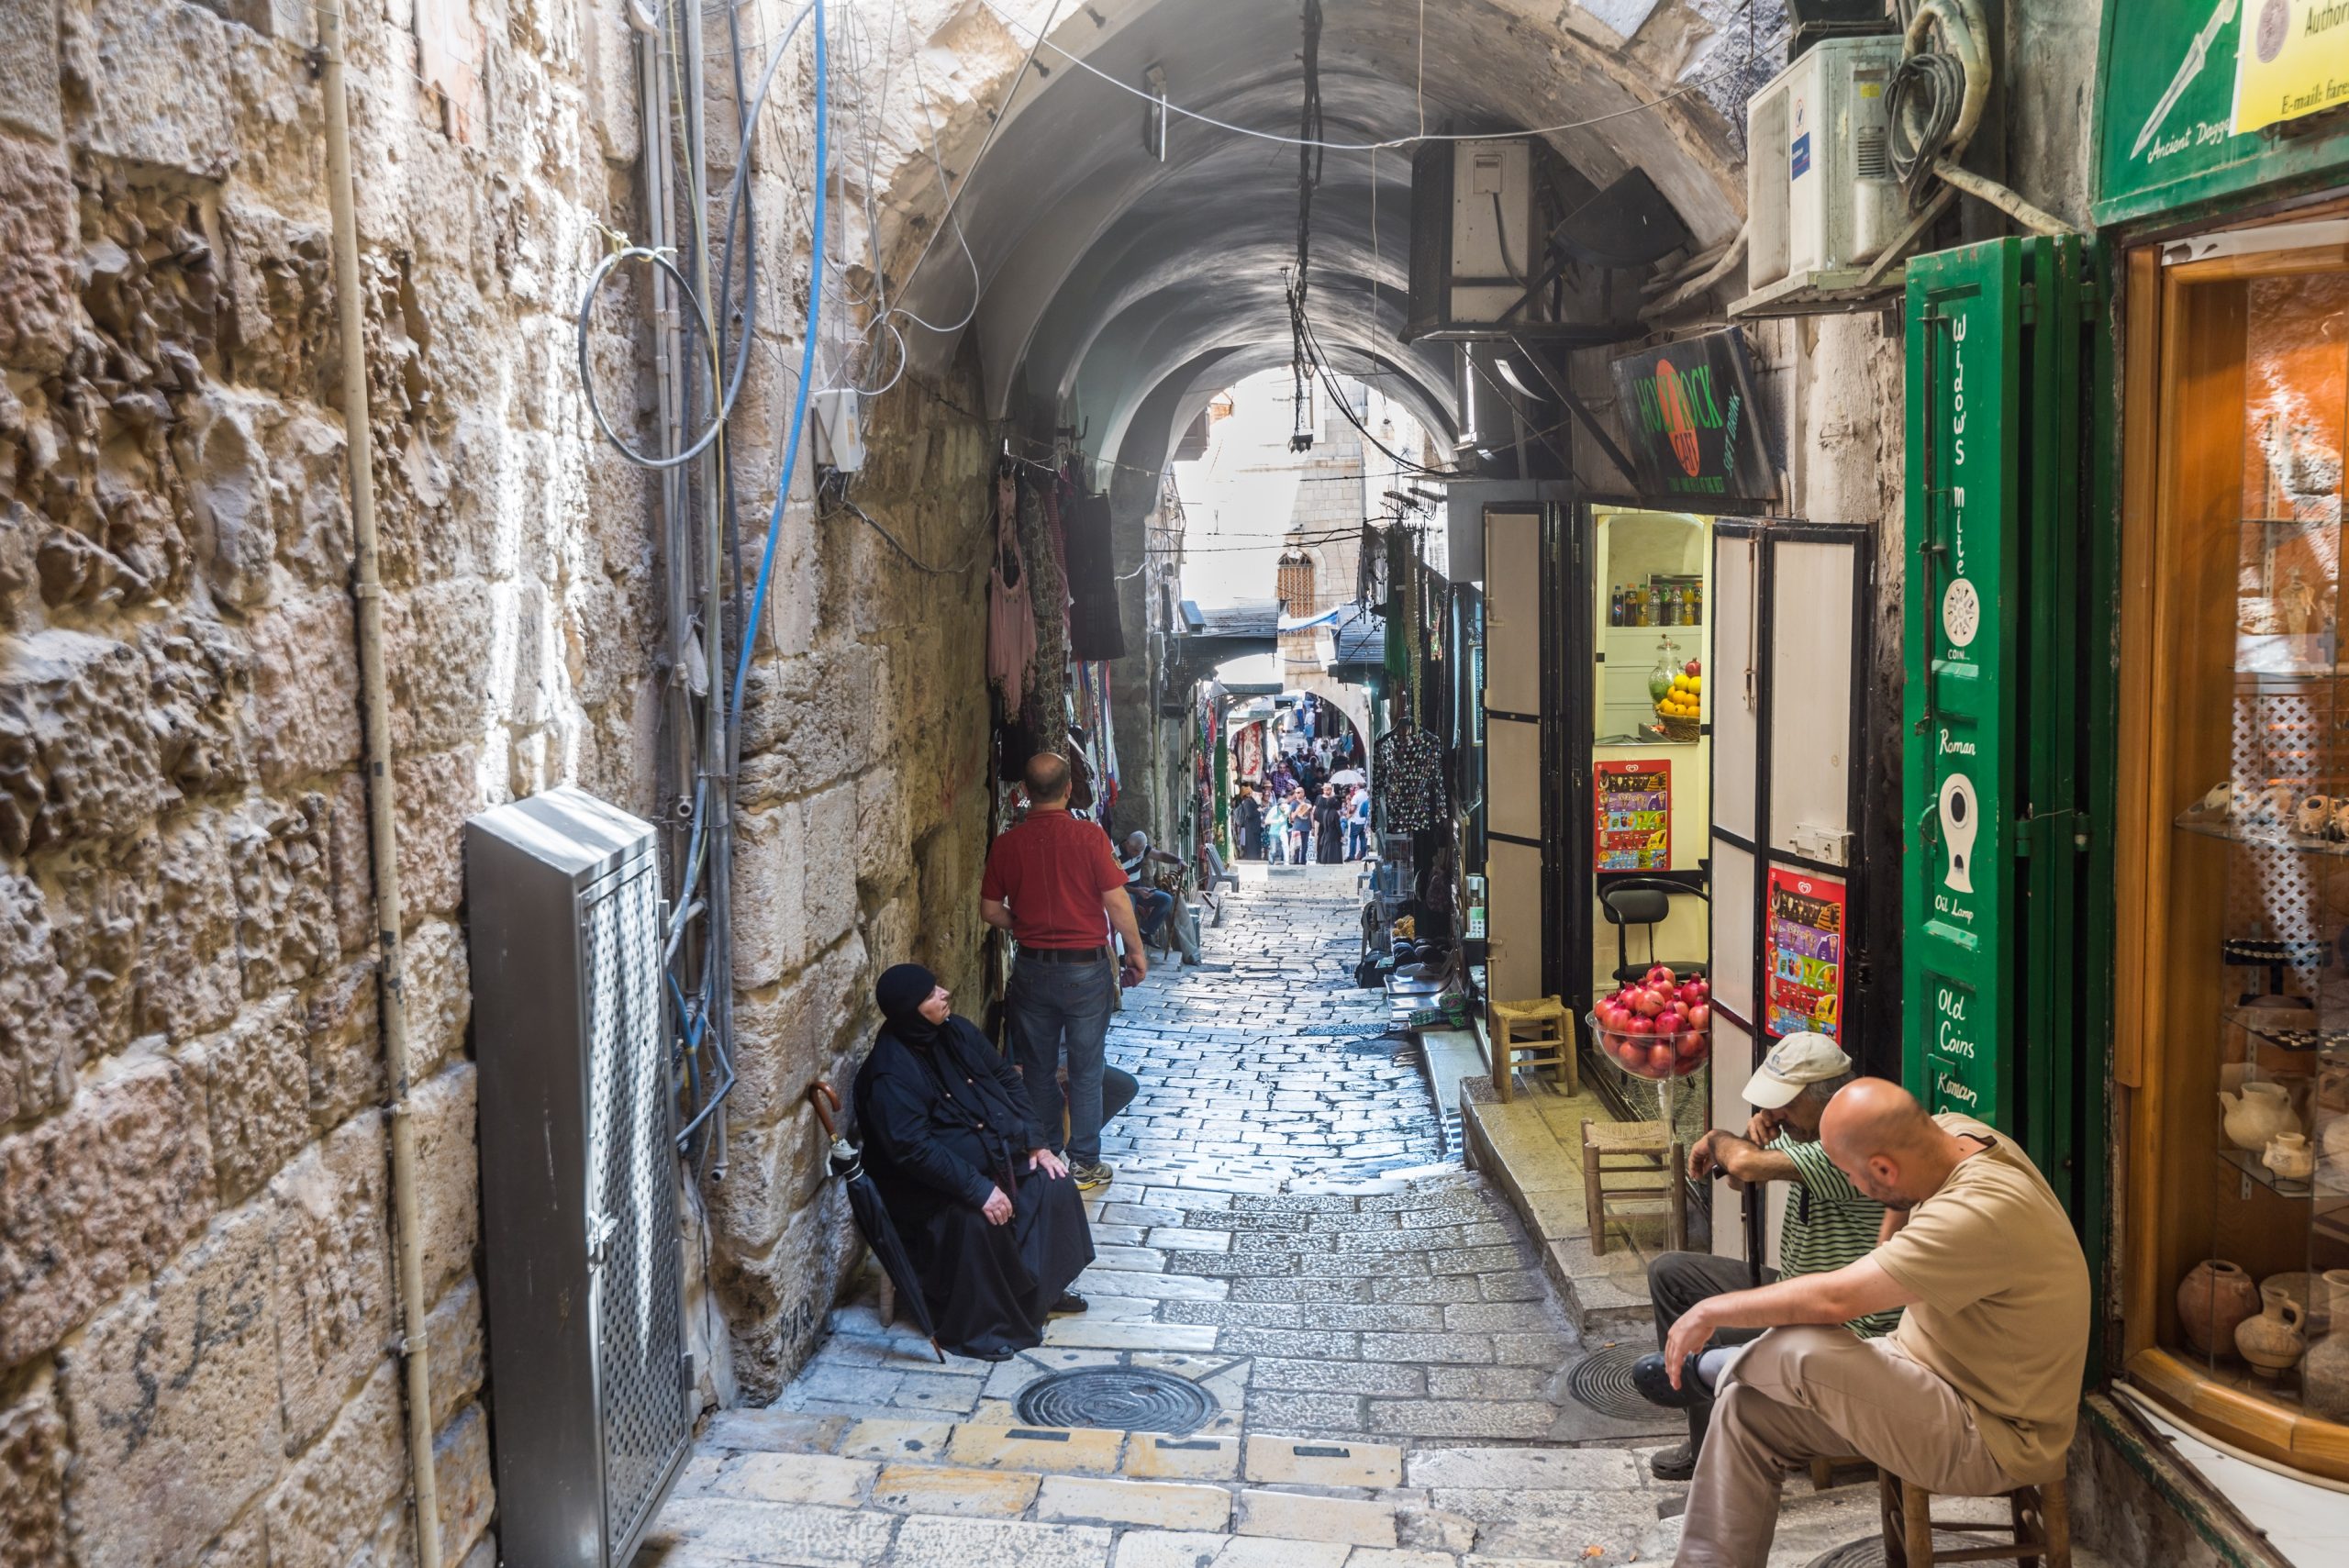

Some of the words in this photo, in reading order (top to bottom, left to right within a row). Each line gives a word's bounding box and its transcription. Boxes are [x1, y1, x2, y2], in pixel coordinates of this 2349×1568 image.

[2281, 83, 2323, 115] E-mail:
[2147, 127, 2192, 164] Ancient
[1671, 365, 1723, 431] ROCK
[1954, 486, 1965, 575] mite
[1939, 728, 1976, 757] Roman
[1934, 894, 1948, 913] Oil
[1951, 898, 1974, 925] Lamp
[1938, 988, 1966, 1021] Old
[1940, 1020, 1976, 1059] Coins
